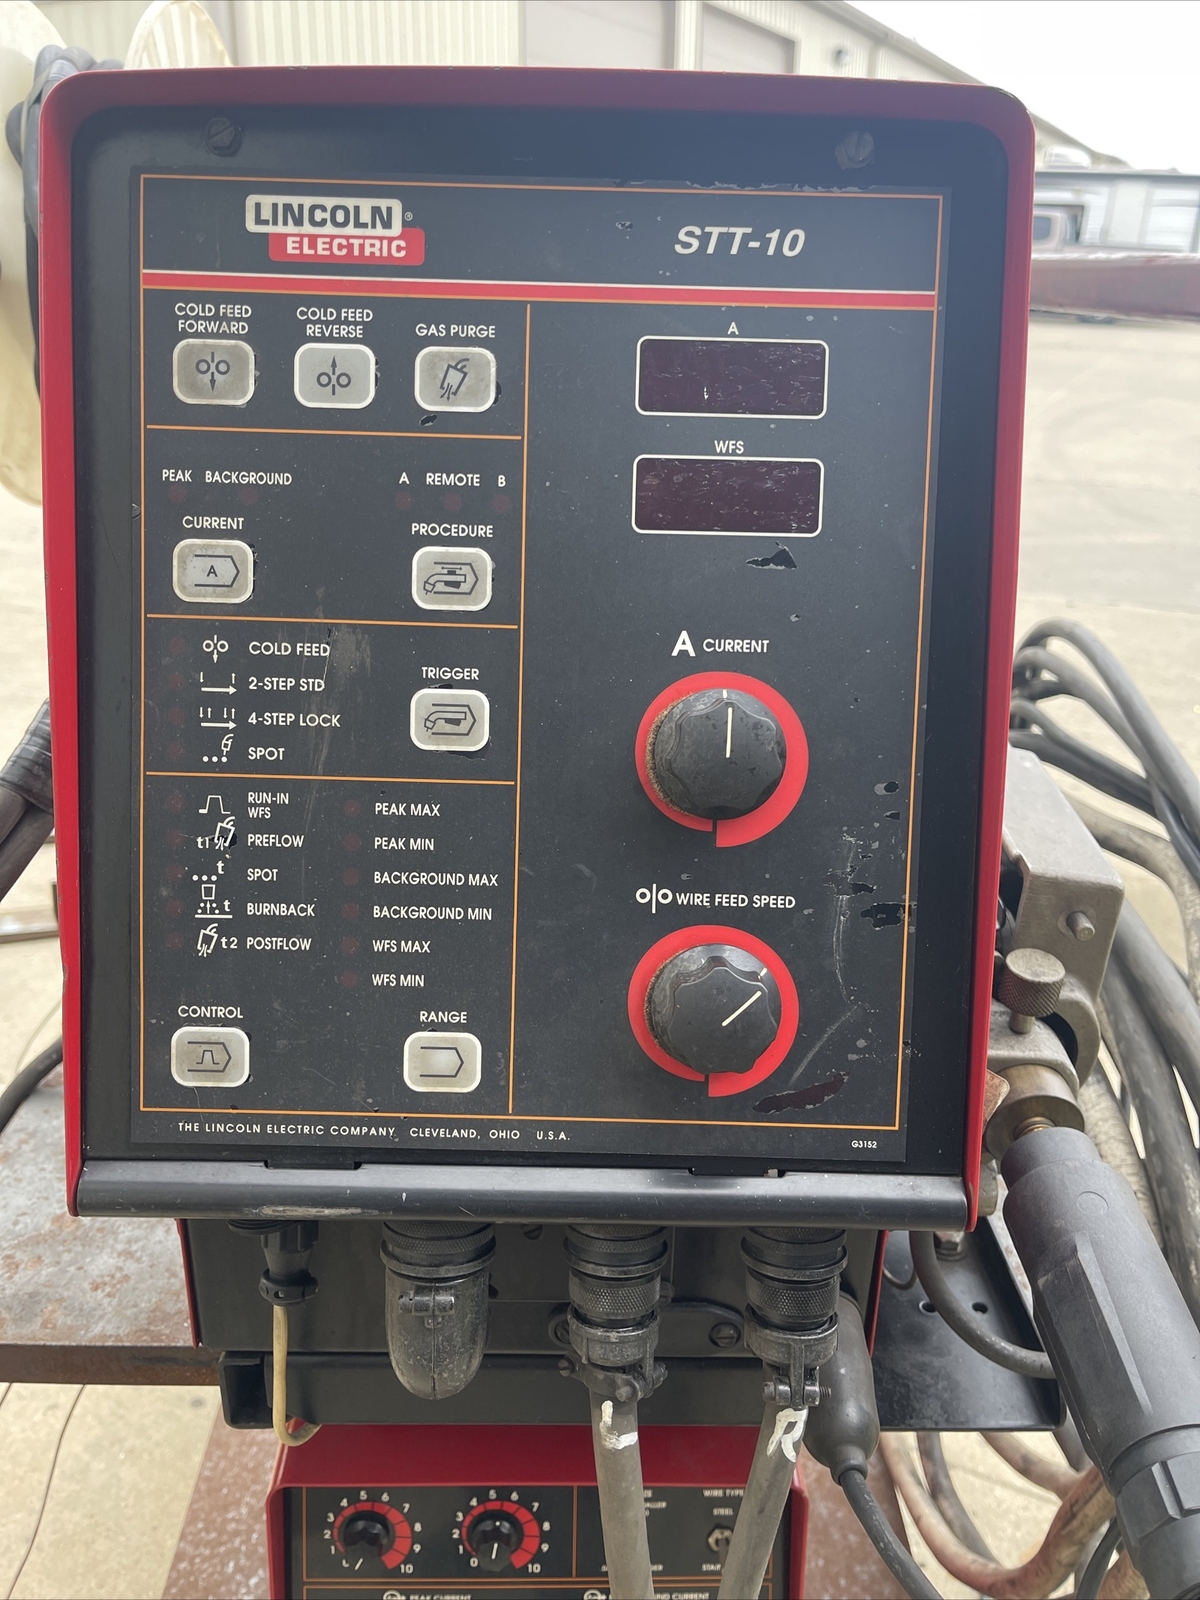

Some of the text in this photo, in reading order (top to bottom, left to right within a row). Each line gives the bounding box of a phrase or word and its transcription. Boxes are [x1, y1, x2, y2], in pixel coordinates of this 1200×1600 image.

[254, 201, 393, 230] LINCOLN
[287, 237, 406, 257] ELECTRIC
[675, 226, 805, 256] STT-10
[174, 302, 252, 318] COLD FEED
[296, 306, 374, 322] COLD FEED
[178, 319, 249, 335] FORWARD
[306, 323, 364, 338] REVERSE
[415, 323, 496, 338] GAS PURGE
[727, 321, 740, 335] A
[714, 439, 745, 455] WFS
[162, 468, 293, 486] PEAK BACKGROUND
[398, 471, 506, 488] A REMOTE B
[182, 515, 245, 530] CURRENT
[411, 522, 494, 538] PROCEDURE
[206, 564, 218, 578] A
[248, 641, 331, 658] COLD FEED
[672, 631, 770, 656] A CURRENT
[421, 666, 480, 681] TRIGGER
[248, 676, 325, 692] 2-STEP STD
[247, 711, 341, 728] 4-STEP LOCK
[247, 746, 286, 761] SPOT
[247, 791, 289, 805] RUN-IN
[247, 806, 271, 819] WFS
[375, 802, 441, 817] PEAK MAX
[247, 833, 305, 848] PREFLOW
[374, 836, 435, 851] PEAK MIN
[246, 867, 279, 882] SPOT
[373, 871, 499, 887] BACKGROUND MAX
[675, 892, 796, 909] WIRE FEED SPEED
[246, 902, 316, 917] BURNBACK
[373, 905, 492, 921] BACKGROUND MIN
[246, 936, 312, 951] POSTFLOW
[372, 939, 431, 954] WFS MAX
[371, 973, 425, 988] WFS MIN
[177, 1005, 244, 1019] CONTROL
[419, 1010, 468, 1024] RANGE
[178, 1122, 572, 1142] THE LINCOLN ELECTRIC COMPANY CLEVELAND, OHIO U.S.A.
[850, 1139, 878, 1149] G3152
[339, 1497, 348, 1507] 4
[359, 1490, 368, 1501] 5
[381, 1491, 390, 1502] 6
[469, 1497, 478, 1507] 4
[488, 1489, 497, 1500] 5
[510, 1491, 519, 1501] 6
[402, 1502, 411, 1514] 7
[531, 1501, 540, 1512] 7
[326, 1512, 335, 1523] 3
[455, 1511, 464, 1522] 3
[323, 1529, 332, 1539] 2
[413, 1522, 422, 1532] 8
[451, 1528, 460, 1539] 2
[542, 1521, 551, 1532] 8
[330, 1545, 336, 1555] 1
[412, 1543, 422, 1554] 9
[458, 1544, 464, 1555] 1
[540, 1542, 550, 1553] 9
[400, 1563, 414, 1574] 10
[469, 1557, 479, 1568] 0
[527, 1563, 541, 1574] 10
